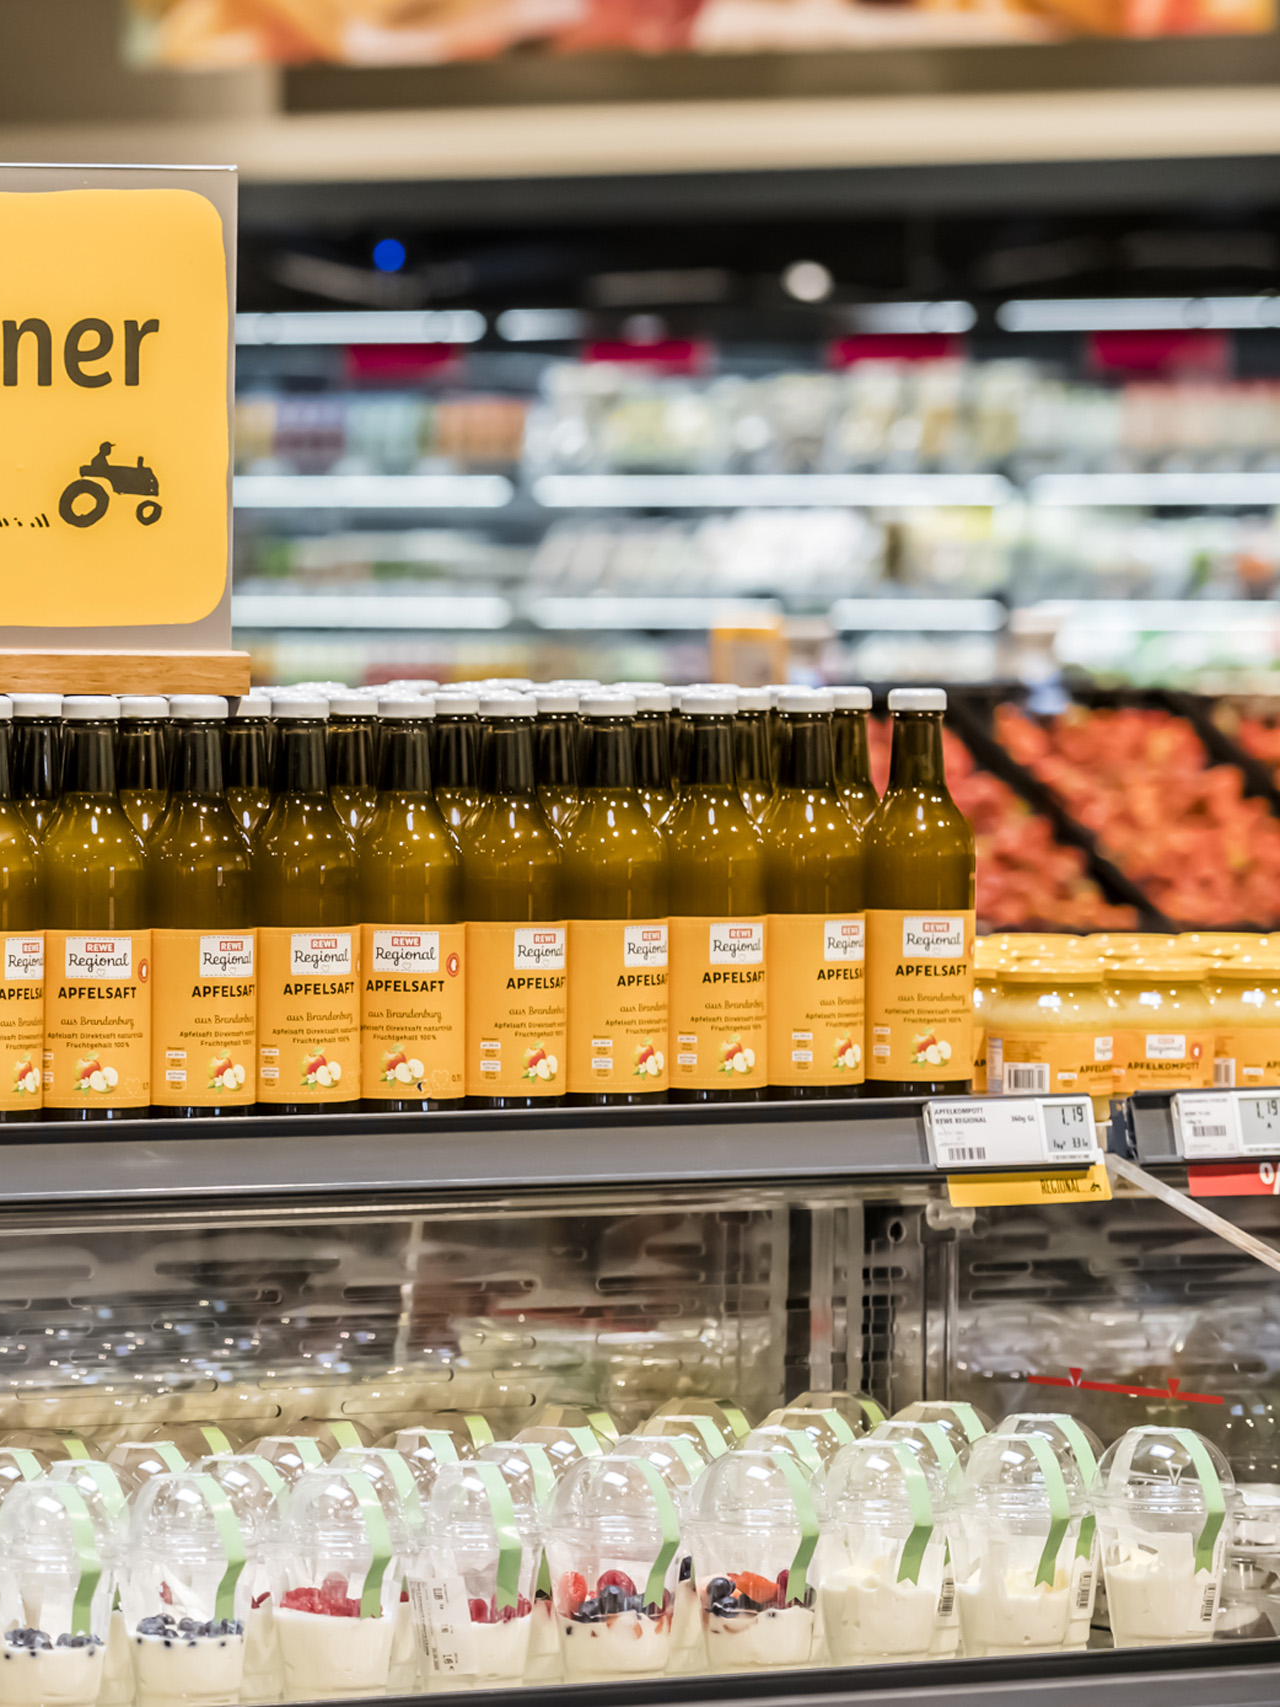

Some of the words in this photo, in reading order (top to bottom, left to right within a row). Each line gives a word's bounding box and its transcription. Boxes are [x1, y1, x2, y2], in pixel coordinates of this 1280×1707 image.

[86, 943, 114, 953] REWE
[220, 941, 243, 951] REWE
[311, 939, 337, 948] REWE
[392, 937, 420, 946] REWE
[713, 939, 761, 957] Regional
[907, 933, 961, 951] Regional
[294, 950, 349, 969] Regional
[376, 947, 436, 966] Regional
[517, 944, 563, 963] Regional
[69, 953, 129, 973] Regional
[203, 951, 252, 972] Regional
[895, 964, 967, 976] APFELSAFT
[506, 976, 566, 989] APFELSAF
[702, 971, 765, 983] APFELSAFT
[192, 984, 255, 998] APFELSAFT
[283, 982, 354, 995] APFELSAFT
[366, 980, 444, 992] APFELSAFT
[58, 987, 137, 999] APFELSAFT
[1127, 1062, 1199, 1070] APFELKOMPOTT
[1062, 1106, 1084, 1126] 1.19
[1040, 1179, 1080, 1194] REGIONAL
